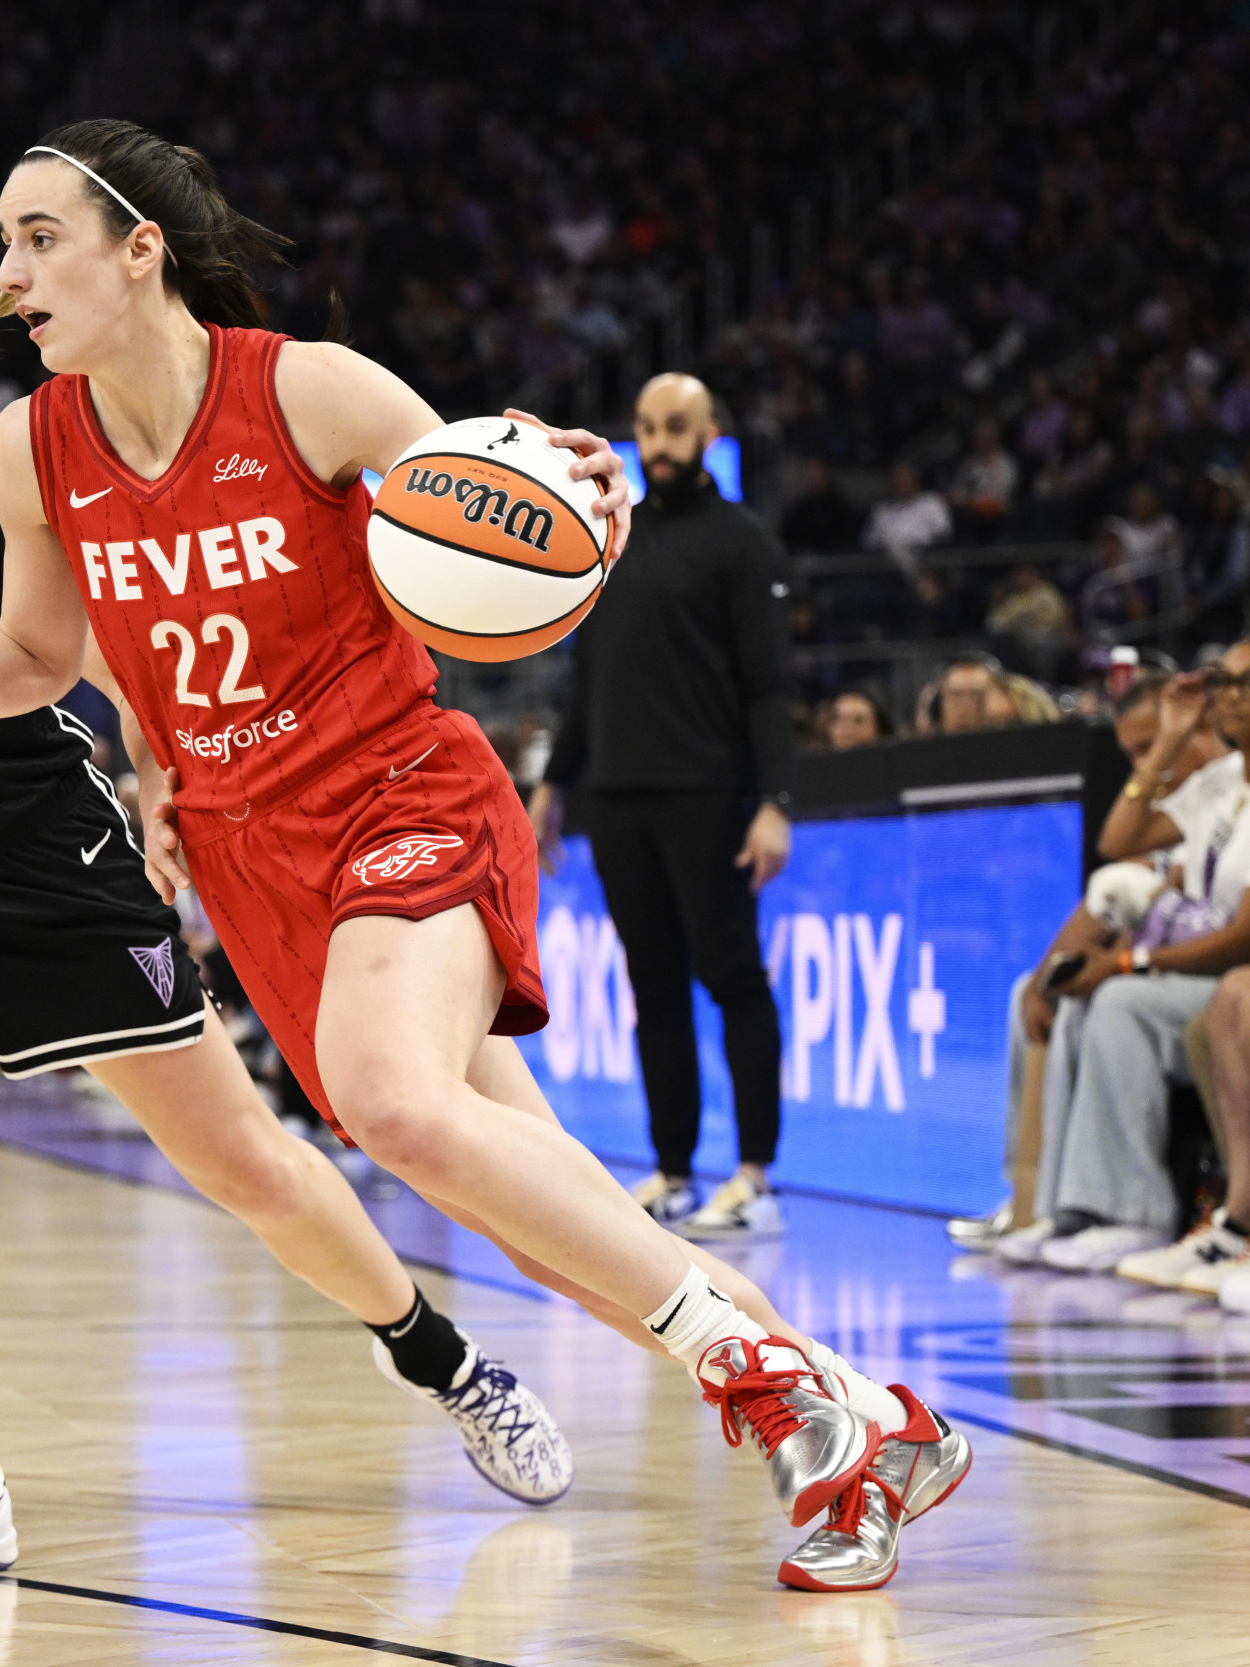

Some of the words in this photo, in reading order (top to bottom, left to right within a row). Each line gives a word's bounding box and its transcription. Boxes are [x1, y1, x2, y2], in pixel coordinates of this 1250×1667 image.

[212, 453, 269, 483] Lilly
[404, 466, 555, 554] Wilson
[80, 515, 302, 602] FEVER
[150, 612, 267, 709] 22
